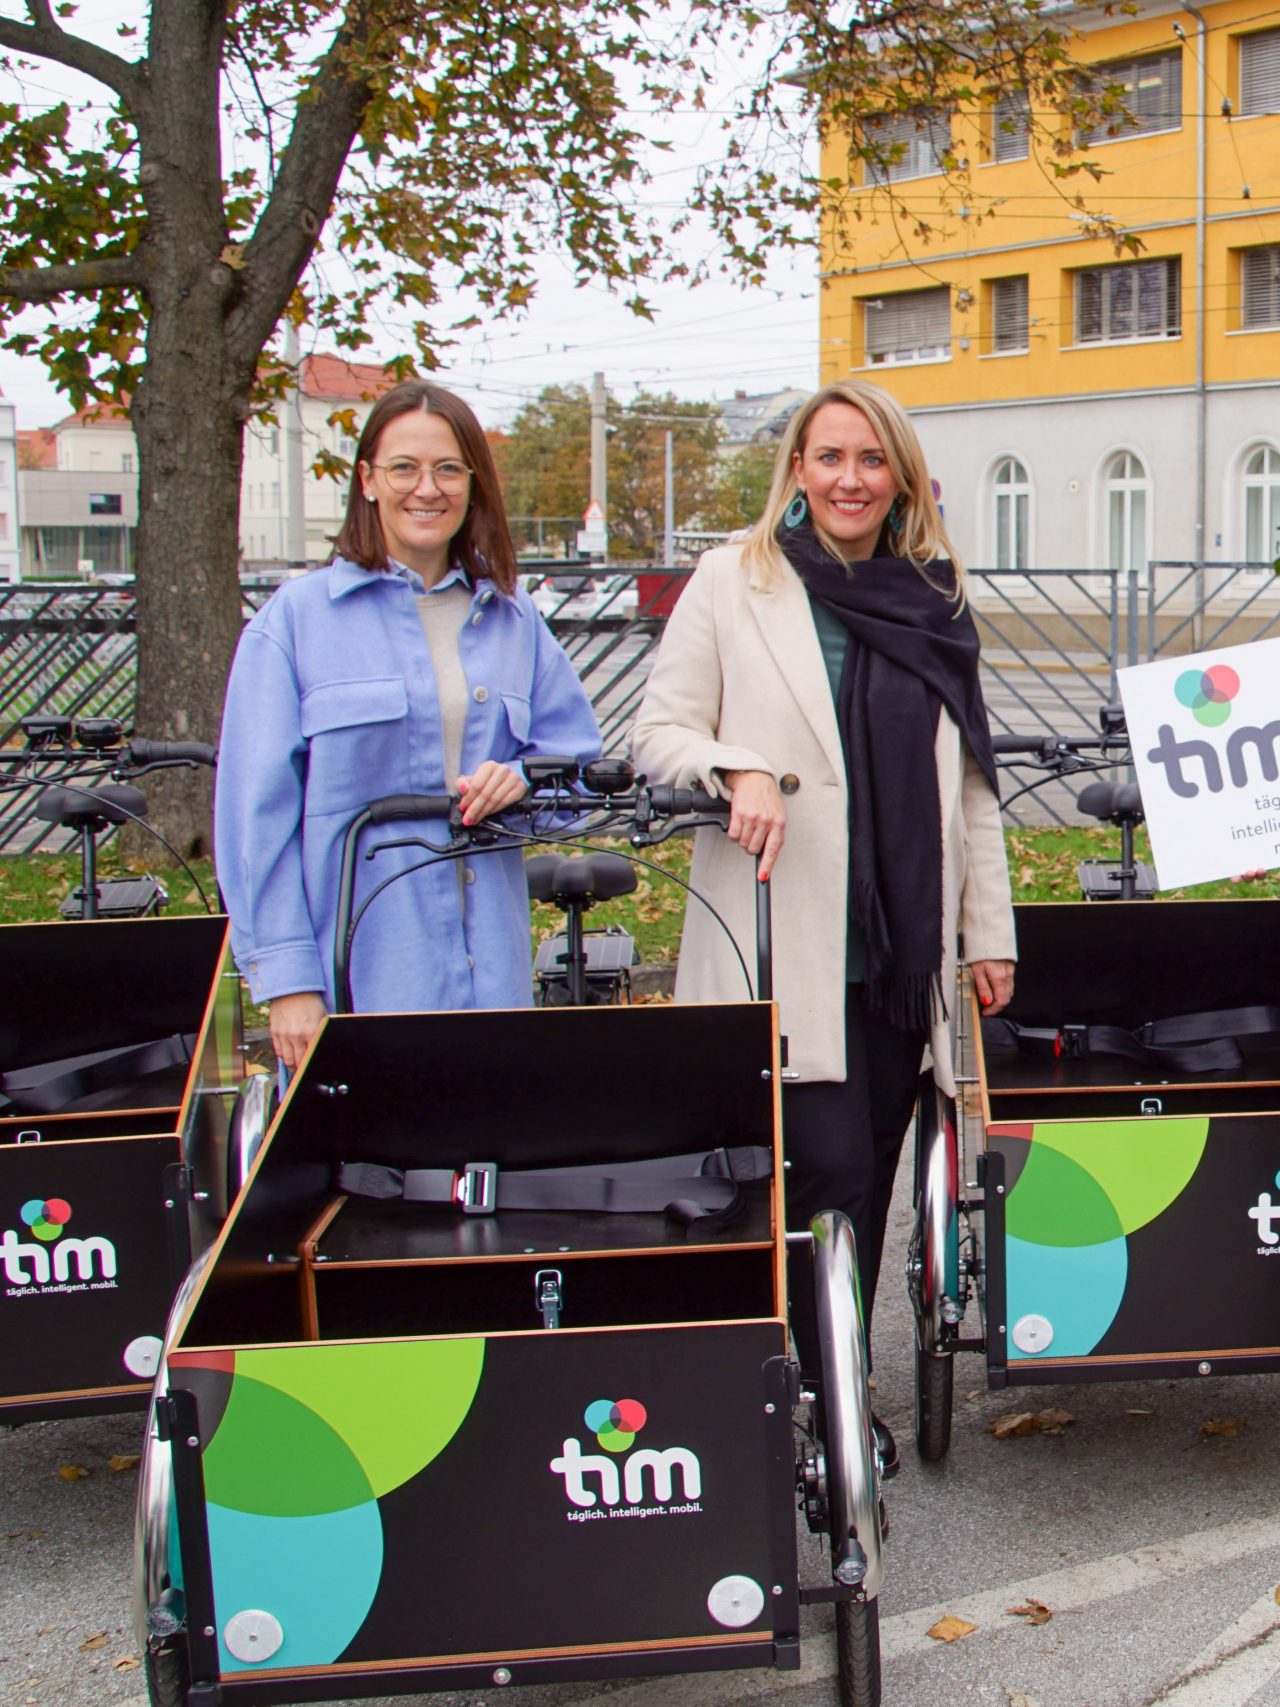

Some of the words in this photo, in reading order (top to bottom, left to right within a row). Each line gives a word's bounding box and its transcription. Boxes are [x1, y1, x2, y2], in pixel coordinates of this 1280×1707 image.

[0, 1230, 117, 1285] tim
[6, 1286, 40, 1297] täglich.
[41, 1283, 90, 1293] intelligent.
[91, 1280, 118, 1289] mobil.
[550, 1438, 702, 1507] tim
[567, 1510, 608, 1522] täglich.
[609, 1504, 668, 1518] intelligent.
[669, 1502, 703, 1514] mobil.
